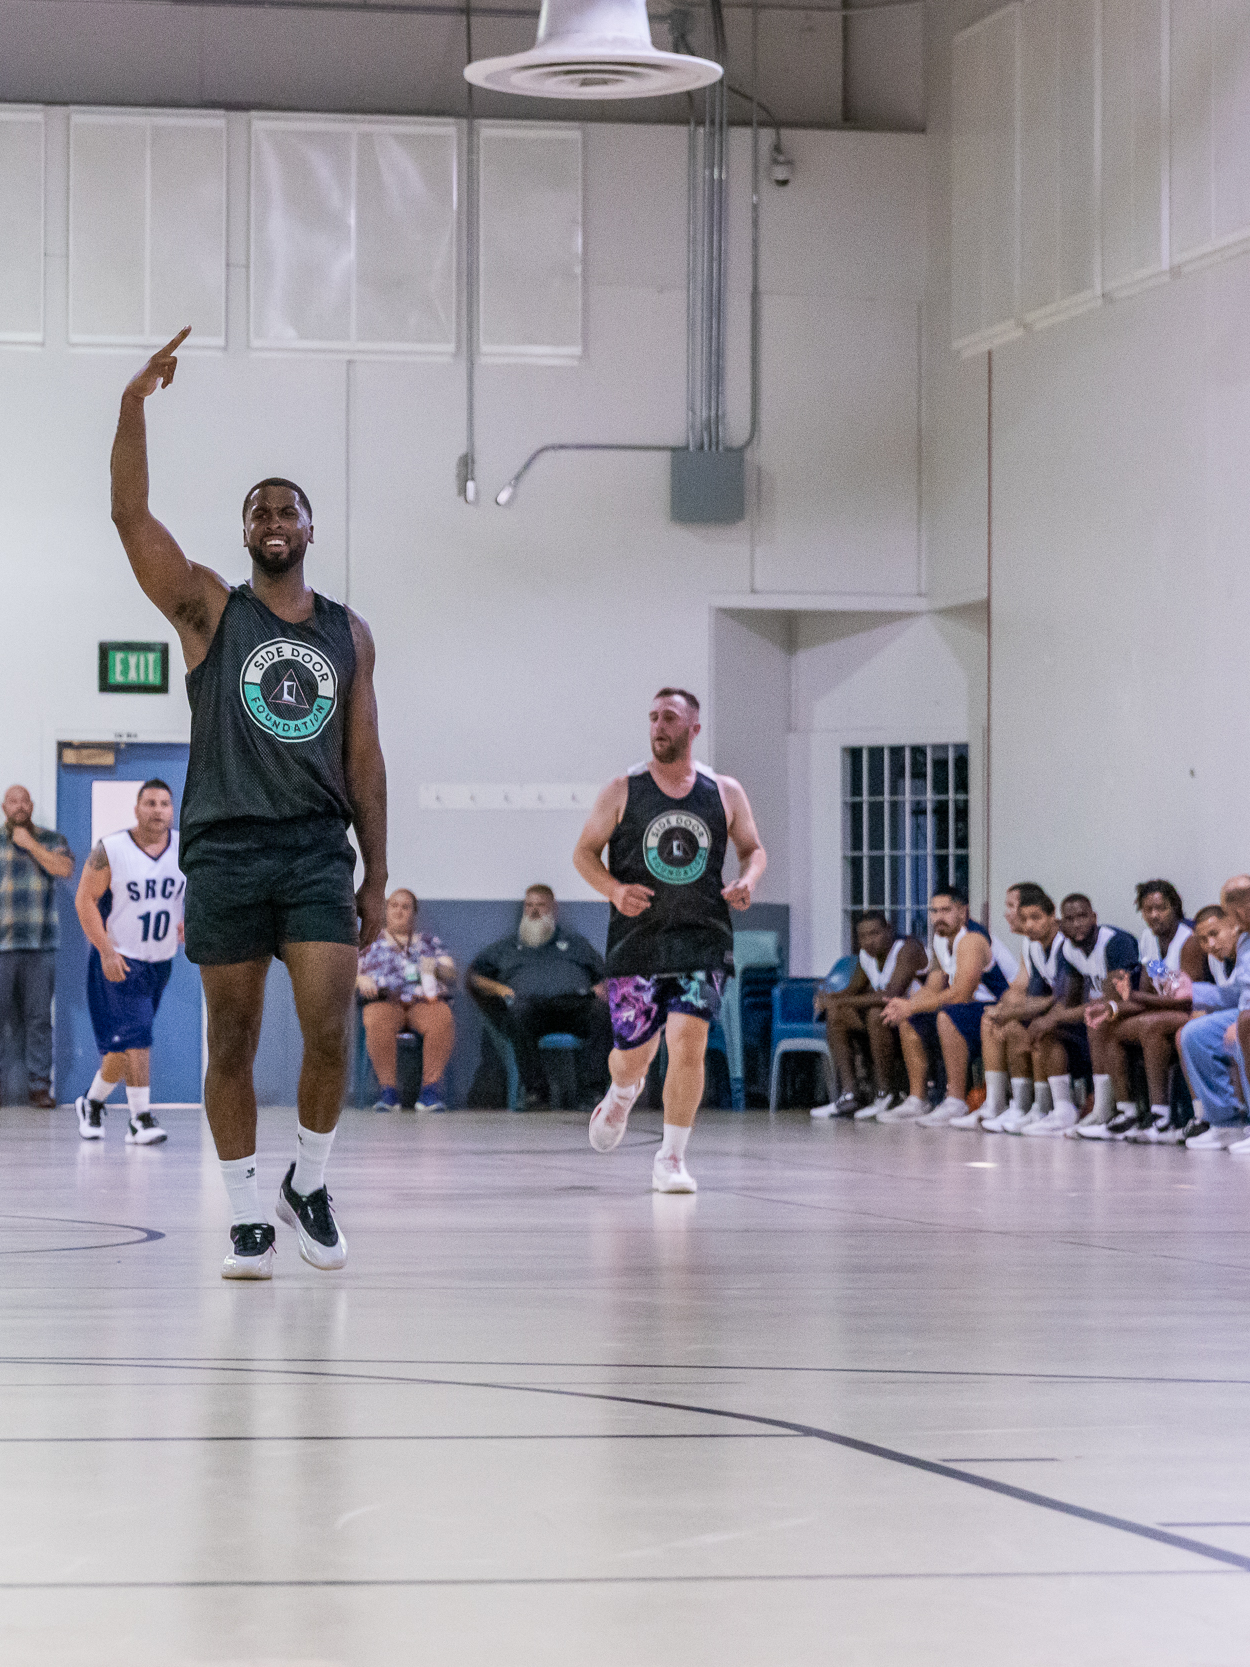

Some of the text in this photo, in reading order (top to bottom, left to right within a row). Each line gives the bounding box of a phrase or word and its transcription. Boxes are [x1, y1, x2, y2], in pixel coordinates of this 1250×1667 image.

[114, 652, 155, 682] EXIT
[254, 646, 329, 682] SIDE DOOR
[251, 696, 325, 732] FOUNDATION
[137, 910, 171, 942] 10
